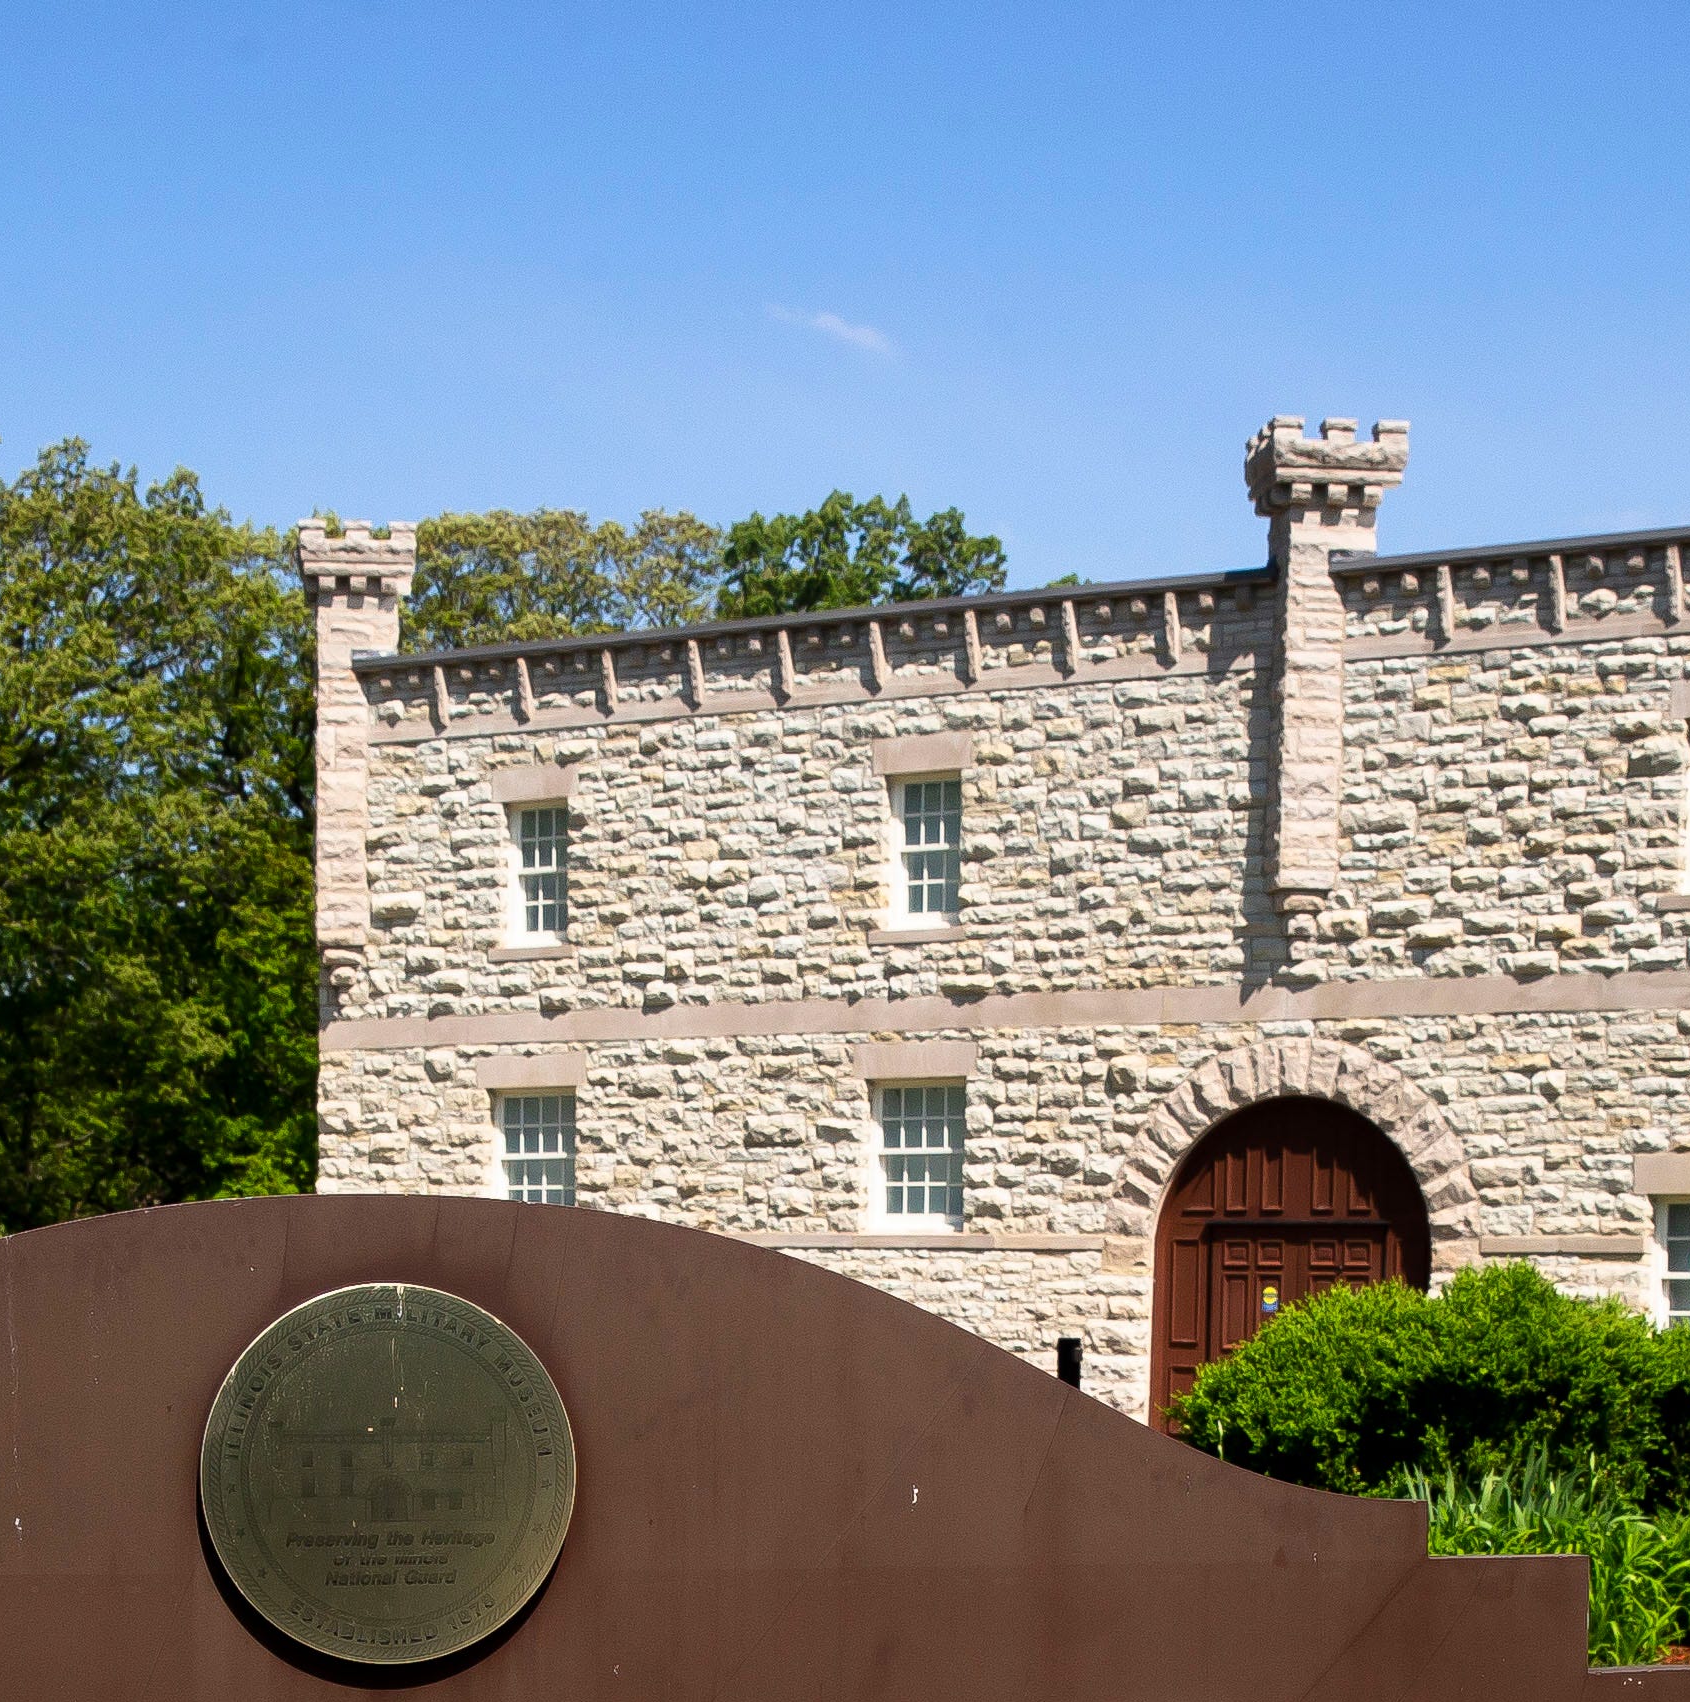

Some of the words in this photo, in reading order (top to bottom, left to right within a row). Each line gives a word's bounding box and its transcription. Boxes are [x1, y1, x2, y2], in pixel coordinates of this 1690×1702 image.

[223, 1354, 283, 1461] ILLINOIS
[287, 1304, 361, 1352] STATE
[492, 1352, 553, 1458] MUSEUM
[285, 1530, 379, 1549] Preserving
[387, 1531, 413, 1547] the
[421, 1530, 496, 1548] Heritage
[332, 1553, 352, 1567] of
[359, 1552, 388, 1566] the
[324, 1570, 398, 1587] National
[403, 1569, 457, 1586] Guard
[289, 1597, 438, 1646] ESTABLISHED
